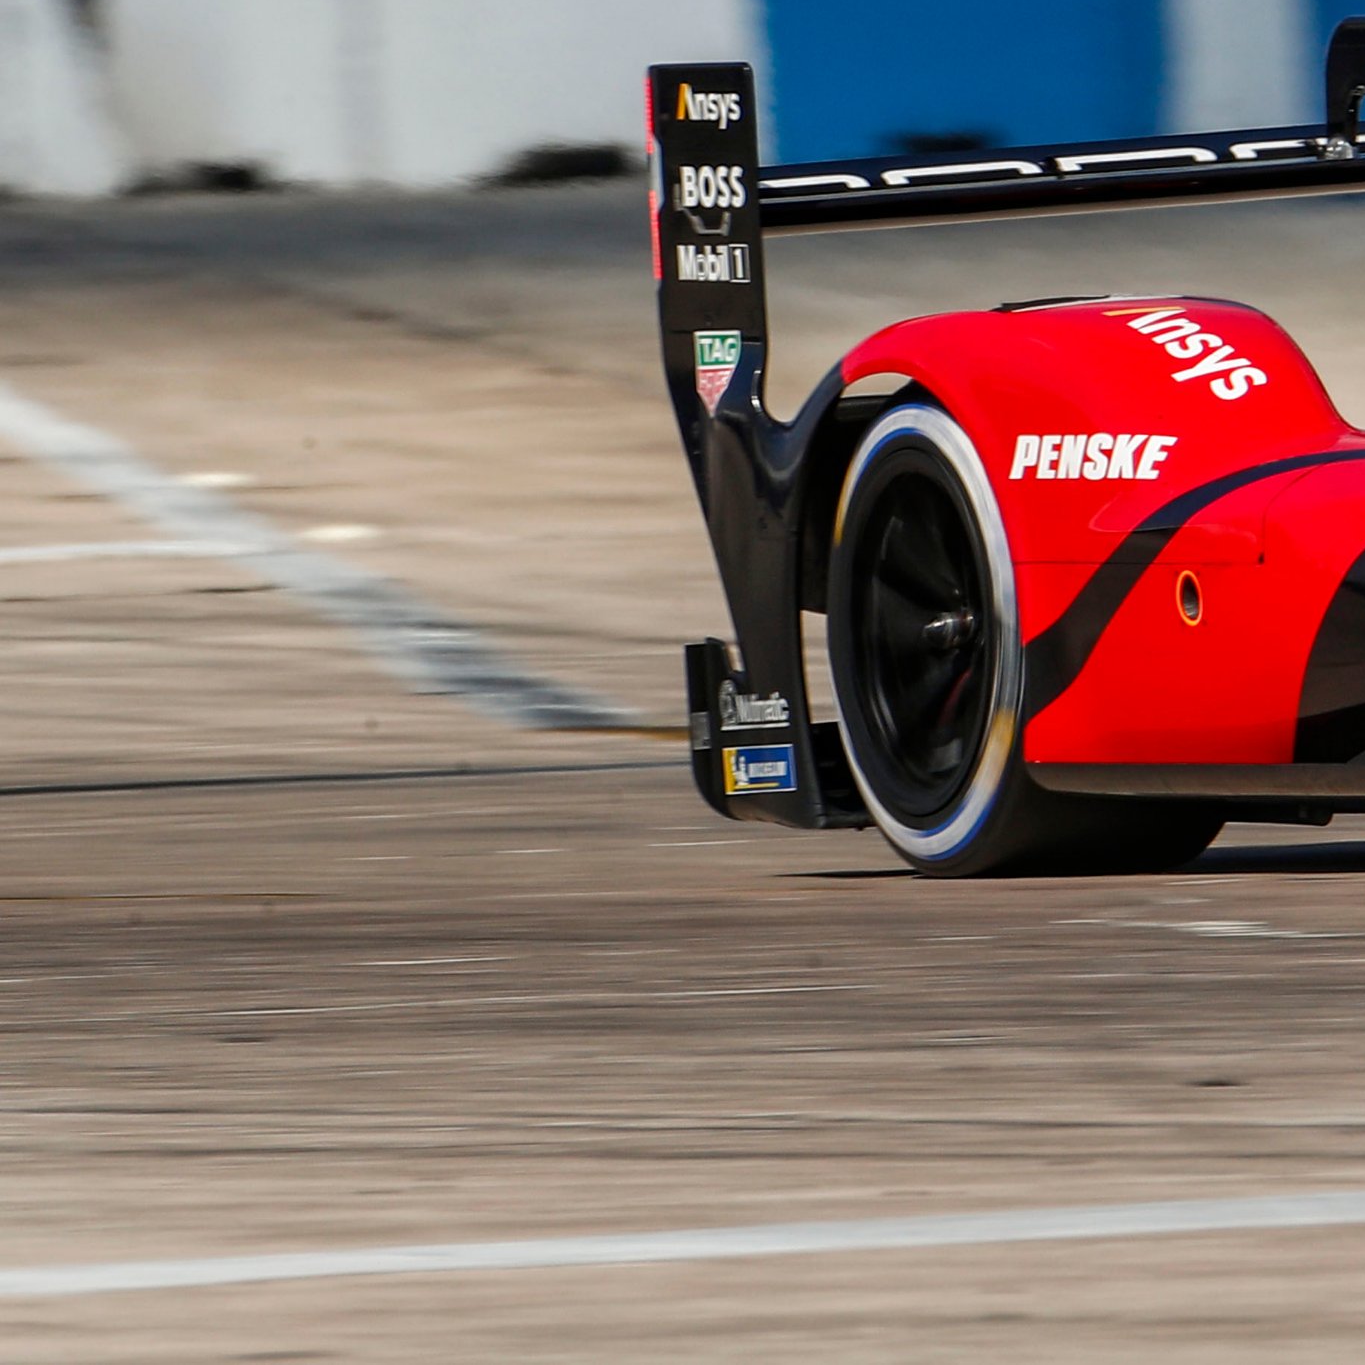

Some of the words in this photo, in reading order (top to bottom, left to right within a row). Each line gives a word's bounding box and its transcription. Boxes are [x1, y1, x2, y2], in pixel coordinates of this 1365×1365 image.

[676, 83, 741, 129] Ansys
[679, 166, 746, 208] BOSS
[676, 244, 730, 281] Mobil
[701, 338, 737, 364] TAG
[1102, 306, 1268, 400] Ansys
[1008, 432, 1179, 480] PENSKE
